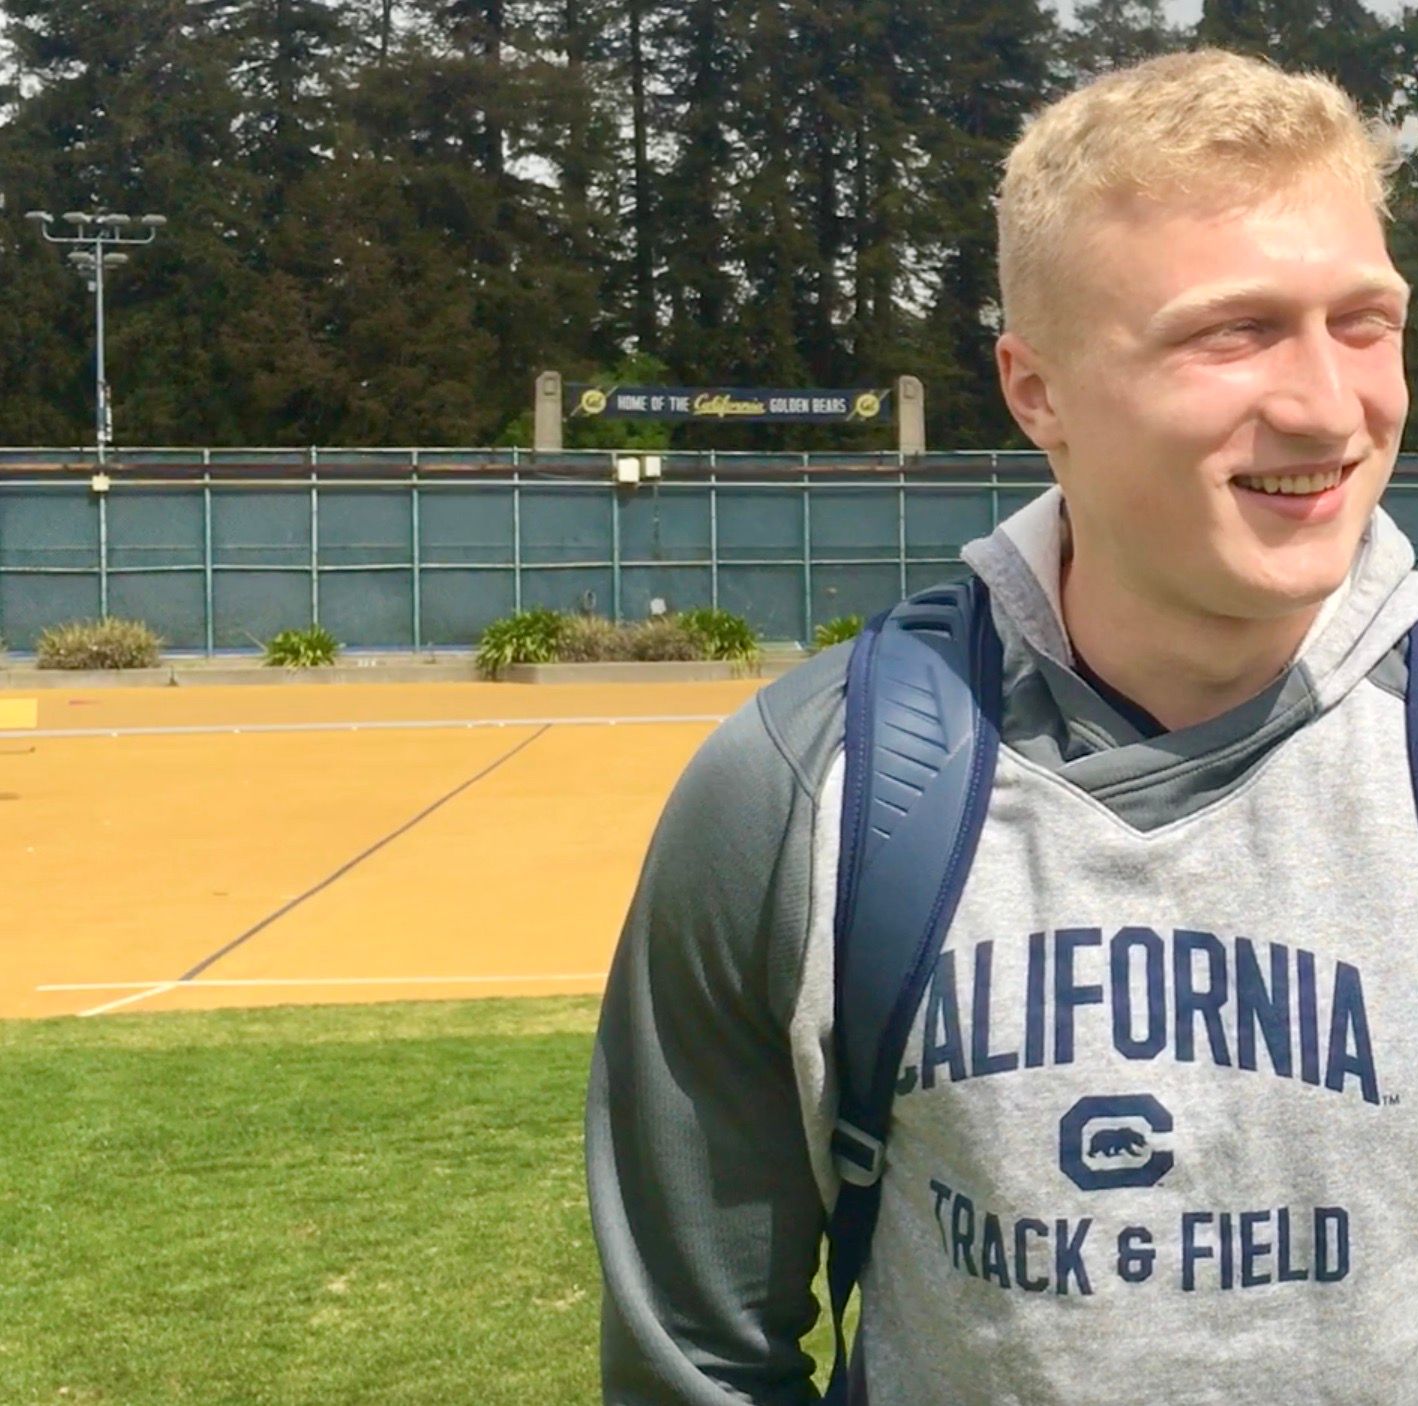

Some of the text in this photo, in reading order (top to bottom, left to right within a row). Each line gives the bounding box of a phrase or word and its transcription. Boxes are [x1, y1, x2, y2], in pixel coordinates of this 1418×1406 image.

[617, 392, 847, 417] HOME OF THE California GOLDEN BEARS
[895, 927, 1381, 1106] ALIFORNIA
[930, 1179, 1350, 1295] TRACK & FIELD
